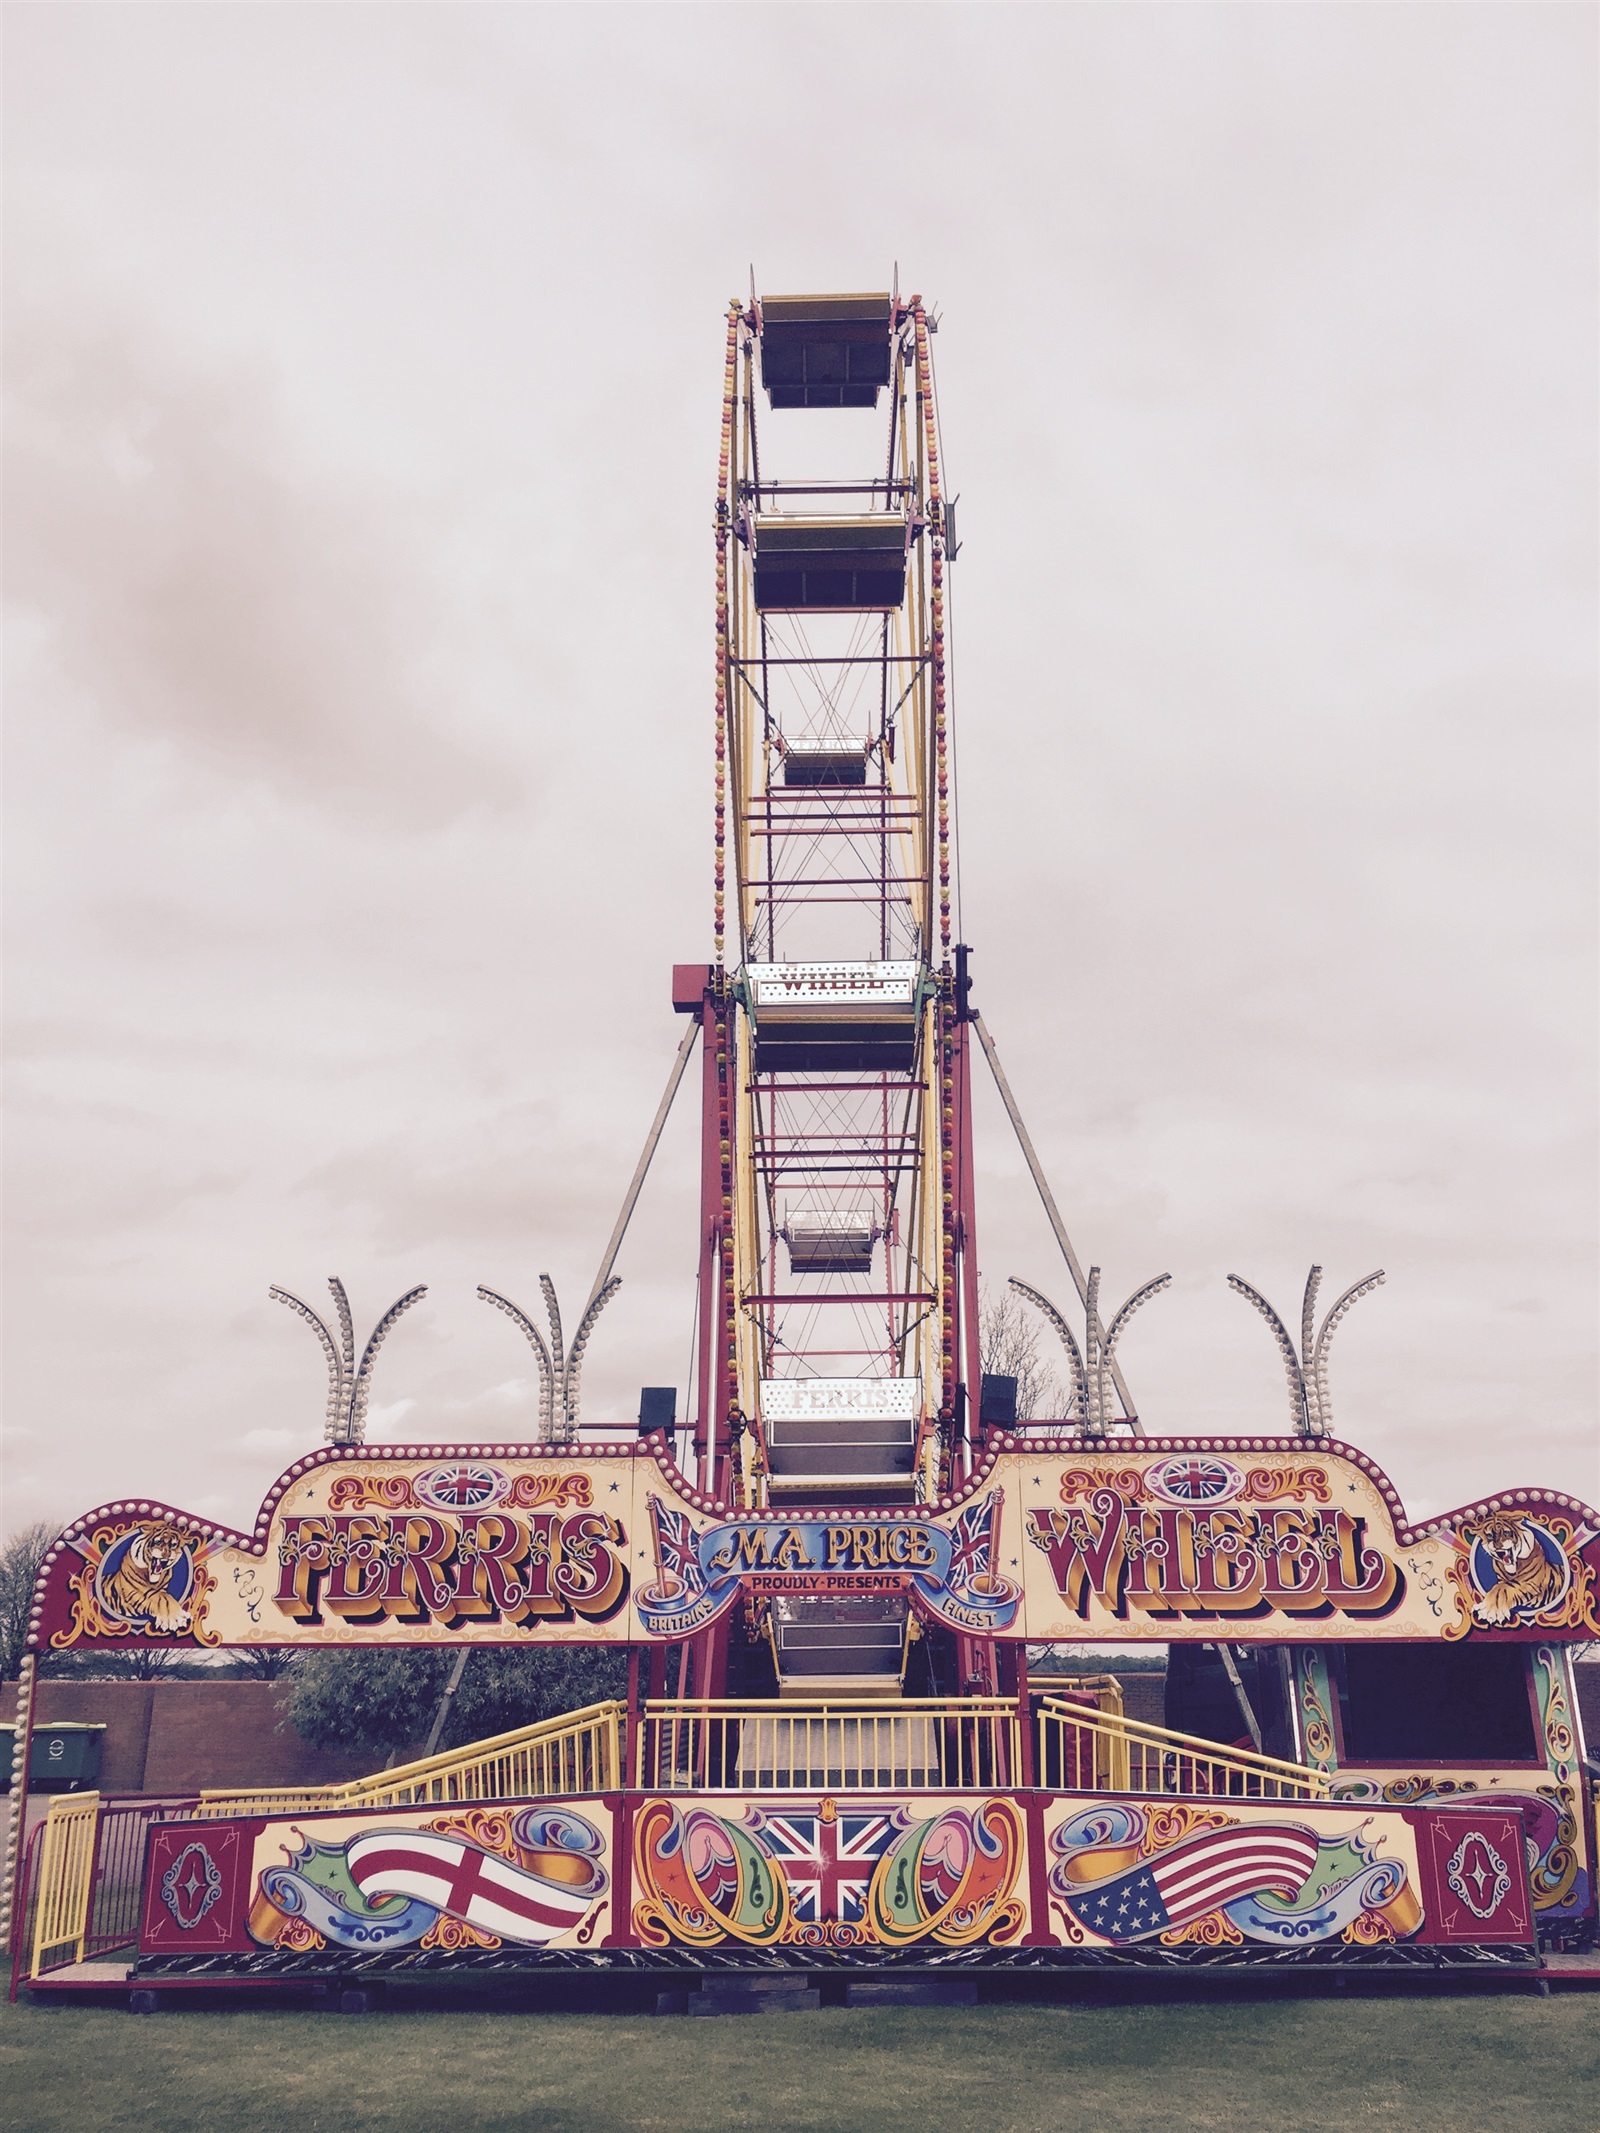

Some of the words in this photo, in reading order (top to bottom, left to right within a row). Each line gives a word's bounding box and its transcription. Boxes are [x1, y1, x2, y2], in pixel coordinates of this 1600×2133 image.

[779, 972, 884, 991] WHEEL
[791, 1389, 889, 1409] FERRIS
[822, 1525, 939, 1568] PRICE
[1026, 1487, 1407, 1621] WHEEL
[273, 1511, 630, 1632] FERRIS
[752, 1576, 818, 1590] PROUDLY
[827, 1575, 901, 1590] PRESENTS
[942, 1597, 997, 1627] FINEST
